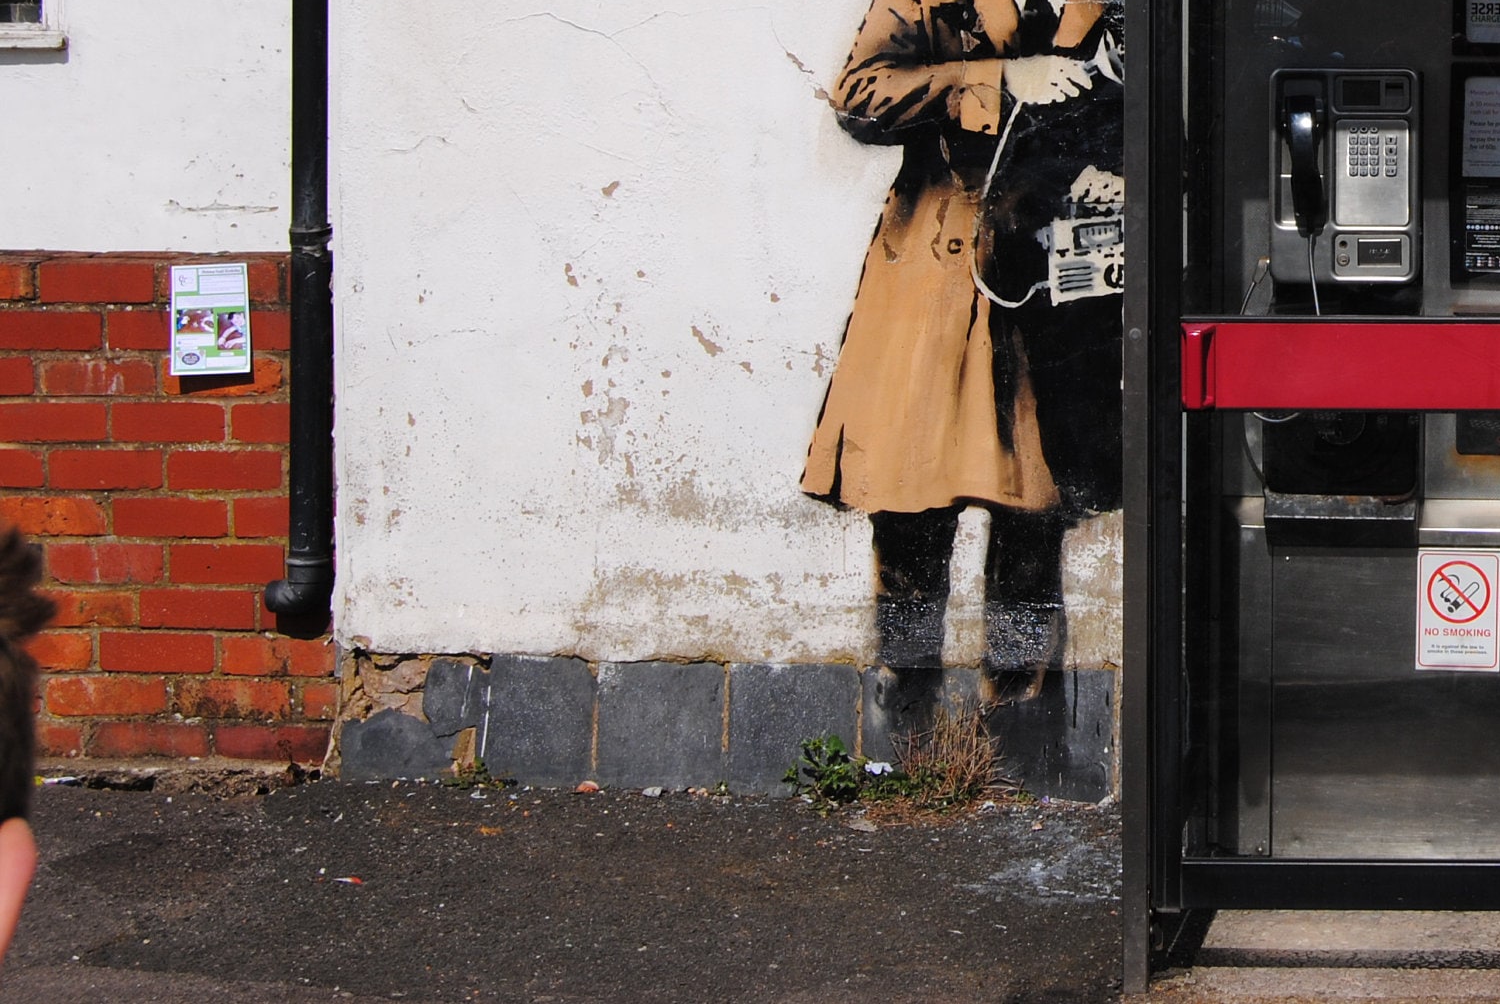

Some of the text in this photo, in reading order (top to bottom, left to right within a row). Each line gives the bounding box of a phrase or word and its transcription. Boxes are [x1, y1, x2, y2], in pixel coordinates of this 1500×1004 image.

[1471, 15, 1500, 23] CHARGE
[1424, 628, 1491, 637] NO SMOKING
